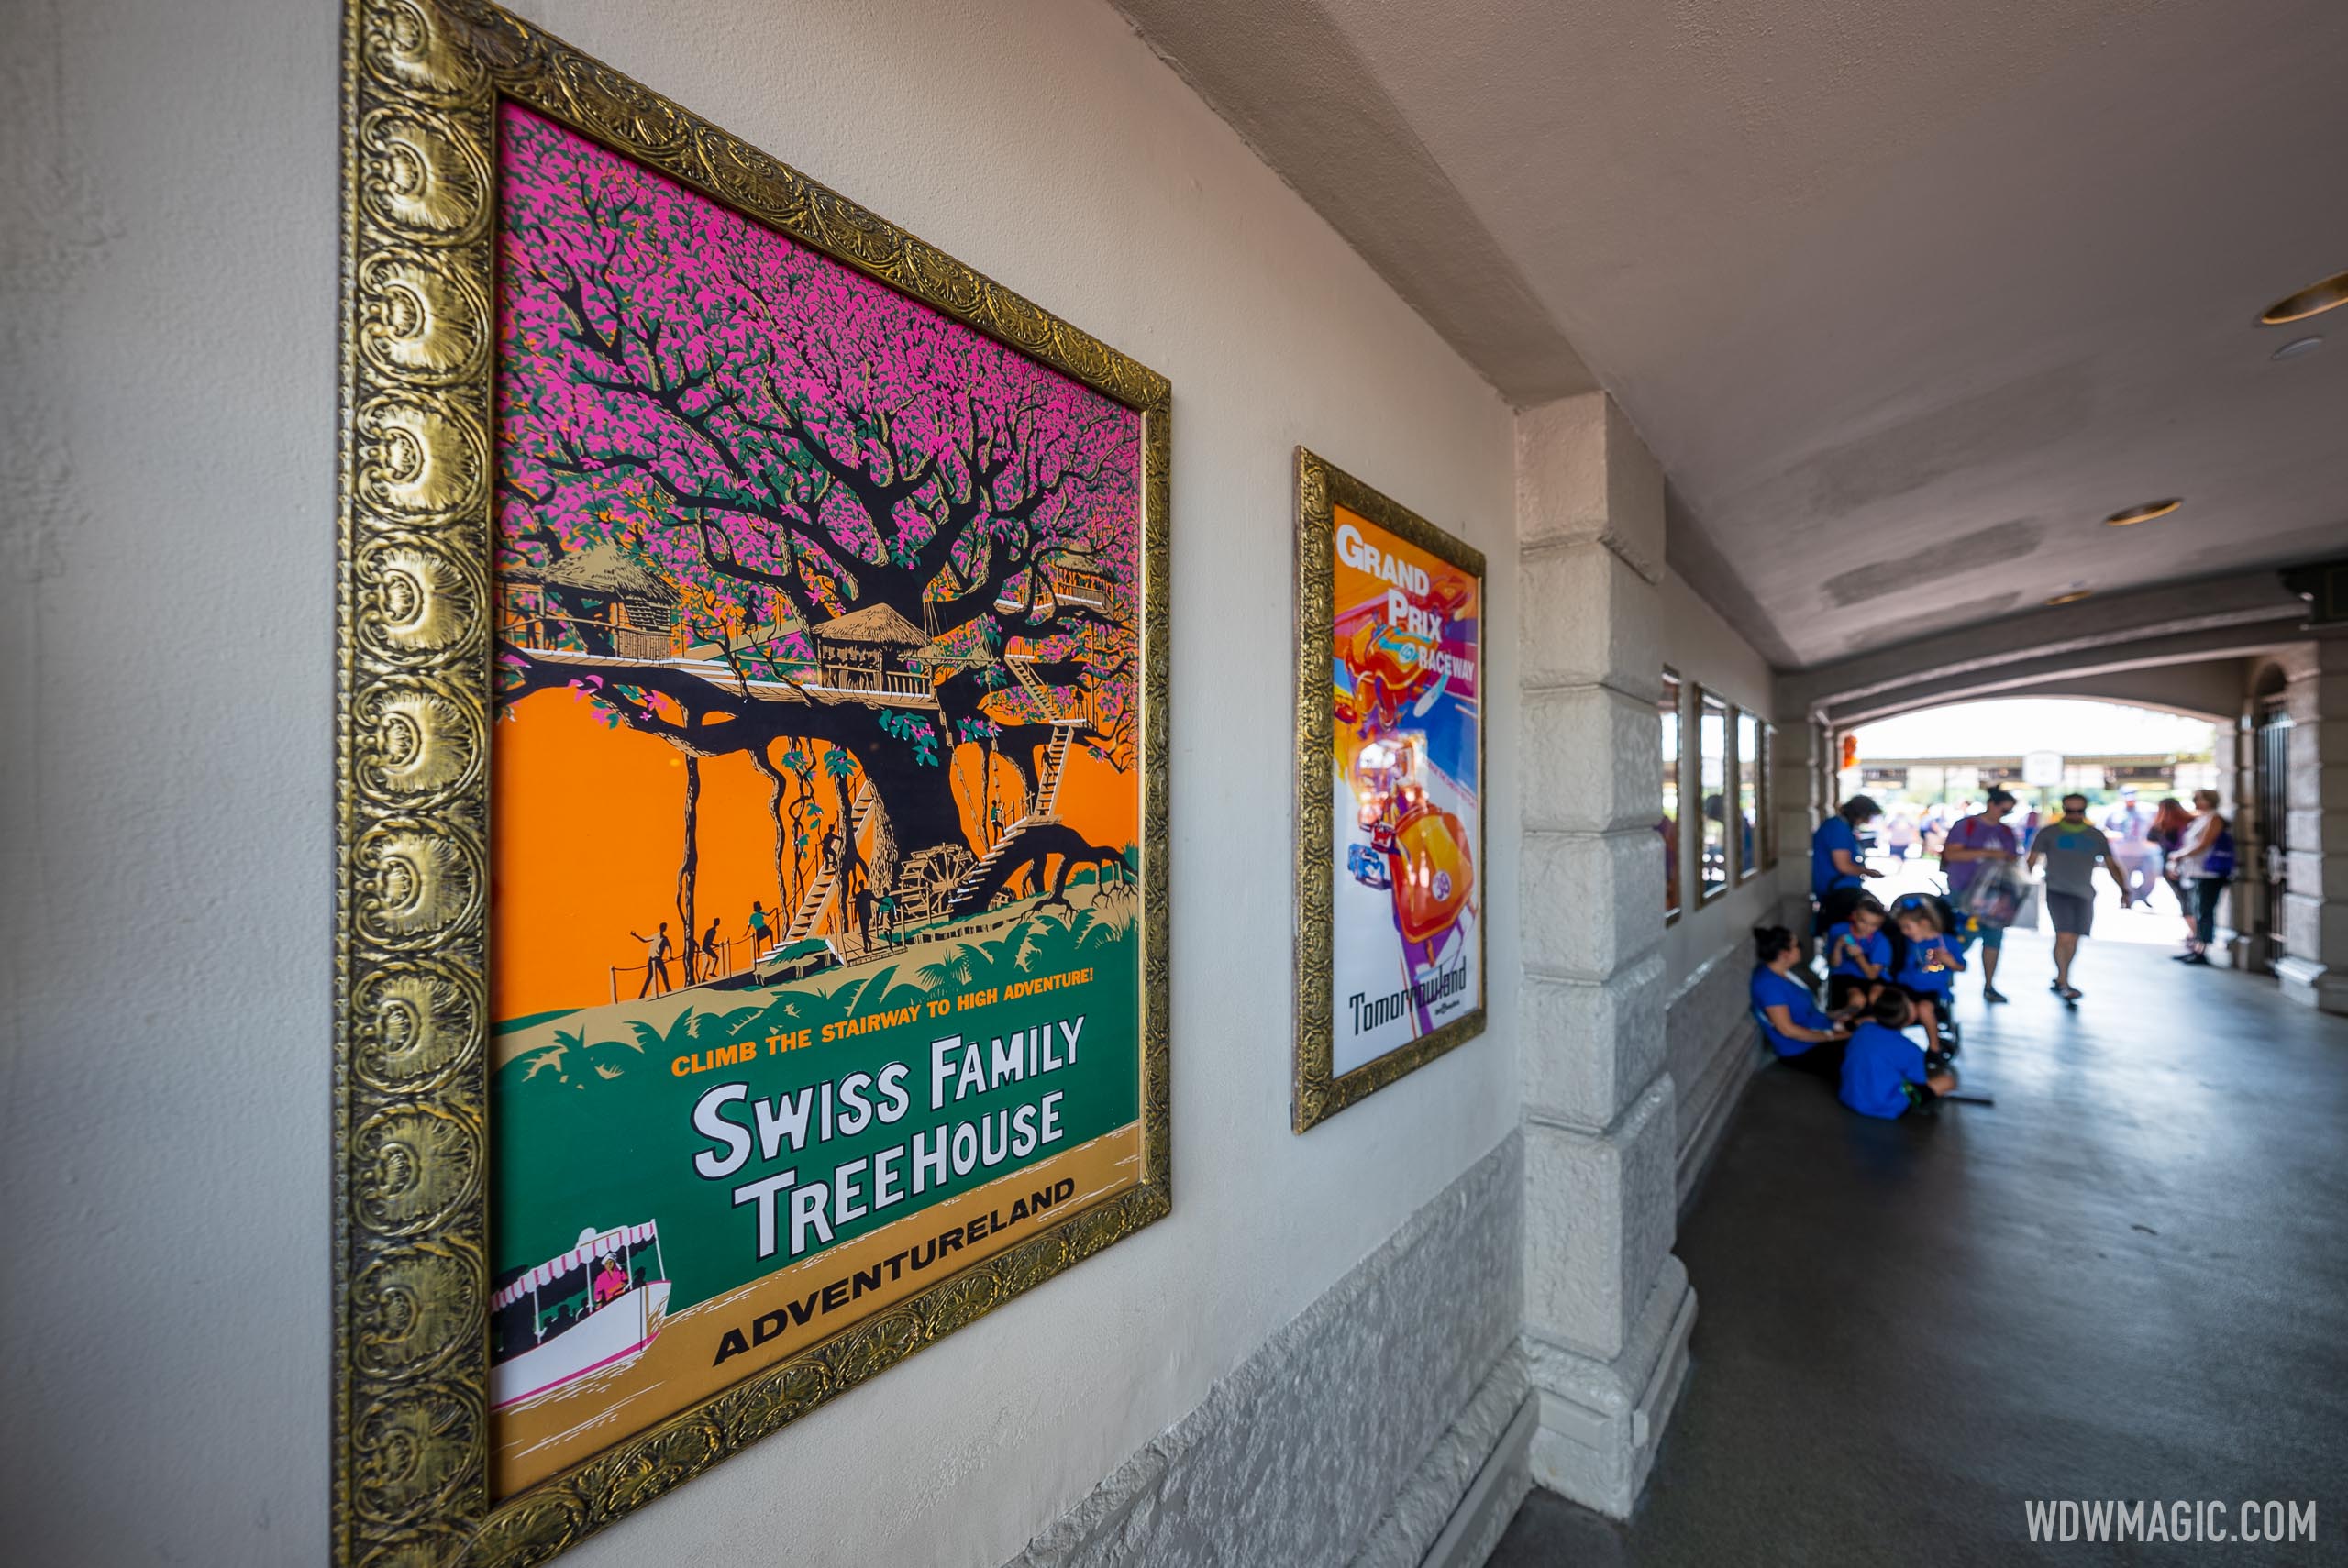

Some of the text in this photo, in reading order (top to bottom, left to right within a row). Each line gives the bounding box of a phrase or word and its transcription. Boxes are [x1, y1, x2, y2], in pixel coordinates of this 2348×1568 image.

[1336, 524, 1430, 597] GRAND
[1388, 588, 1443, 643] PRIX
[1419, 645, 1474, 682] RACEWAY
[670, 967, 1095, 1077] CLIMB THE STAIRWAY TO HIGH ADVENTURE!
[1349, 955, 1467, 1036] Tomorrowland
[691, 1014, 1086, 1181] SWISS FAMILY
[732, 1090, 1065, 1264] TREEHOUSE
[713, 1177, 1076, 1367] ADVENTURELAND
